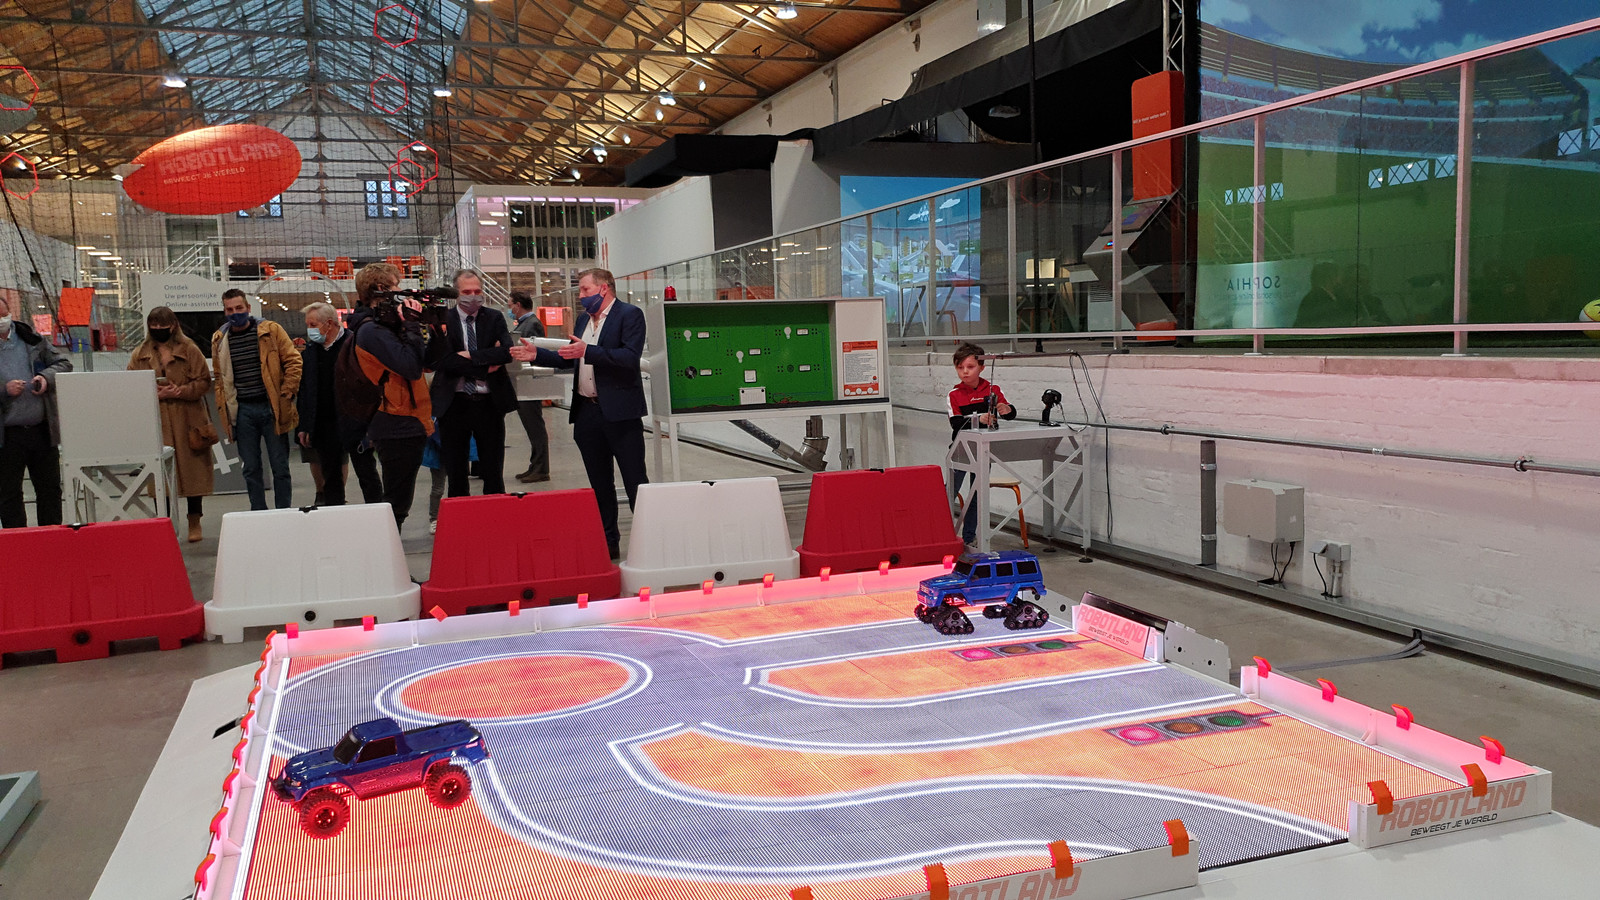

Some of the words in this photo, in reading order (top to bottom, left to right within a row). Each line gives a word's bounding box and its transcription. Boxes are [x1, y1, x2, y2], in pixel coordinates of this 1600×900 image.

[159, 142, 281, 175] ROBOTLAND
[203, 171, 213, 179] JE
[214, 166, 246, 177] WERELD
[1078, 604, 1147, 643] ROBOTLAND
[1378, 780, 1527, 833] ROBOTLAND
[1410, 821, 1451, 837] BEWEEGT
[1451, 819, 1463, 829] JE
[1464, 813, 1498, 826] WERELD
